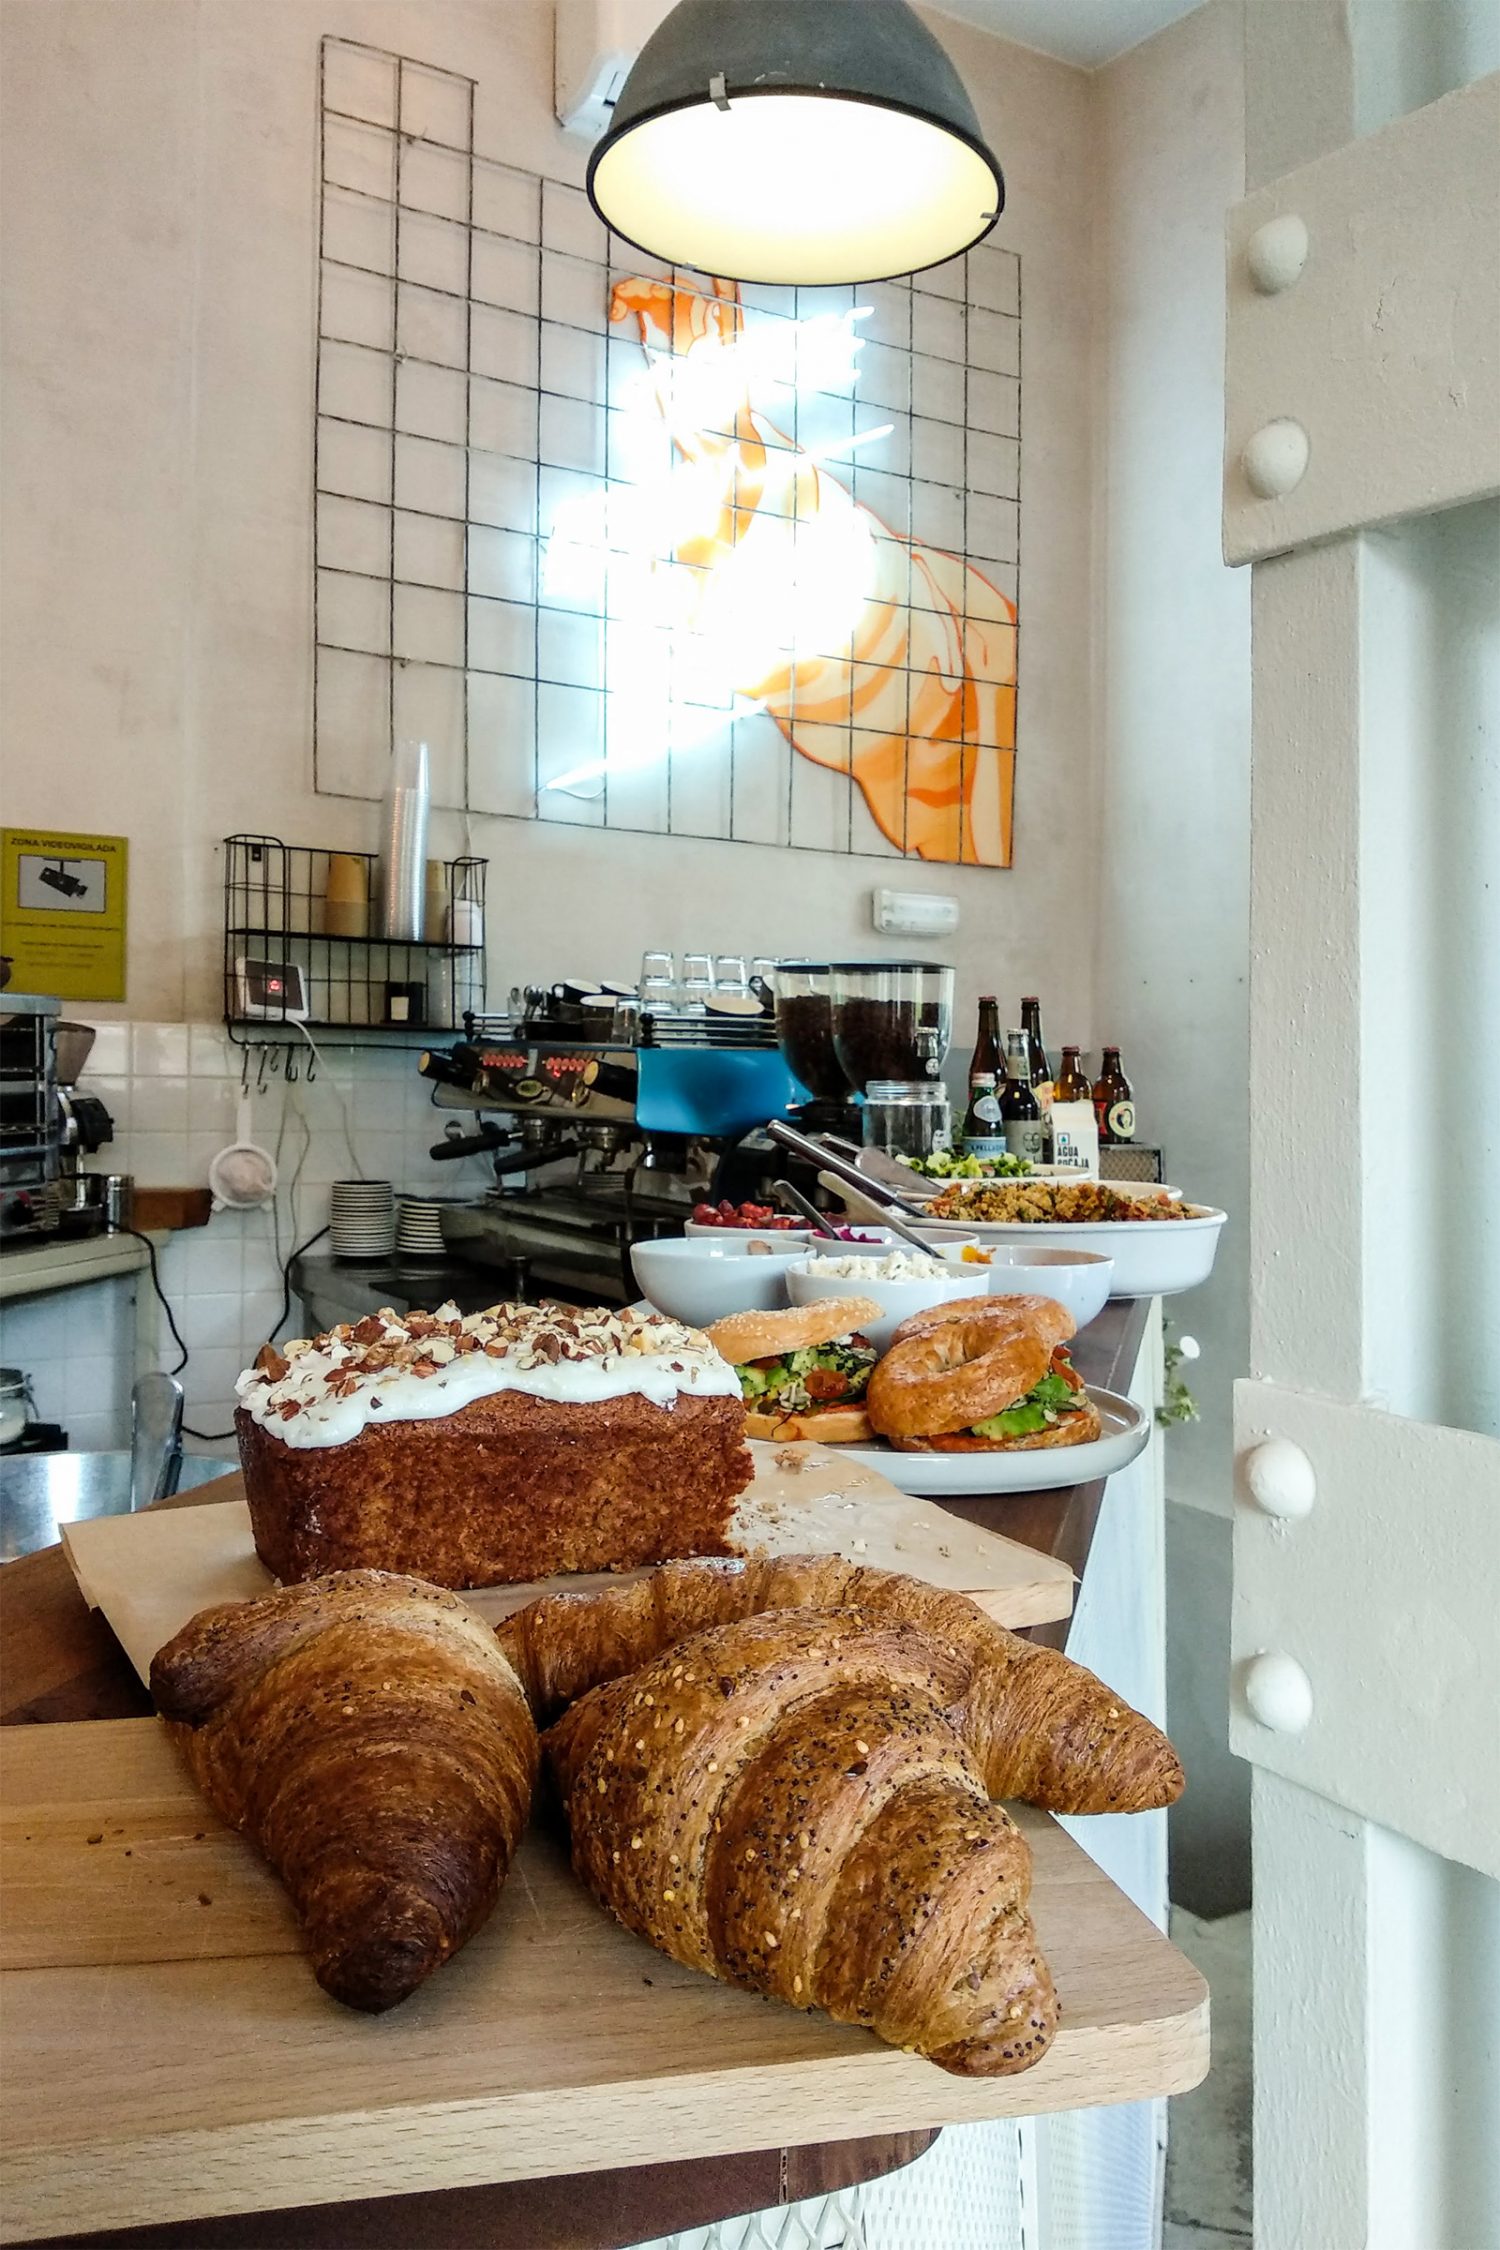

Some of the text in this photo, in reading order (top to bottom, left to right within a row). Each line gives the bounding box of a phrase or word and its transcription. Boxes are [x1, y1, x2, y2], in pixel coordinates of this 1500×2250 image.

[11, 838, 117, 853] ZONA VIDEOVIGILADA
[1057, 1146, 1079, 1157] AGUA
